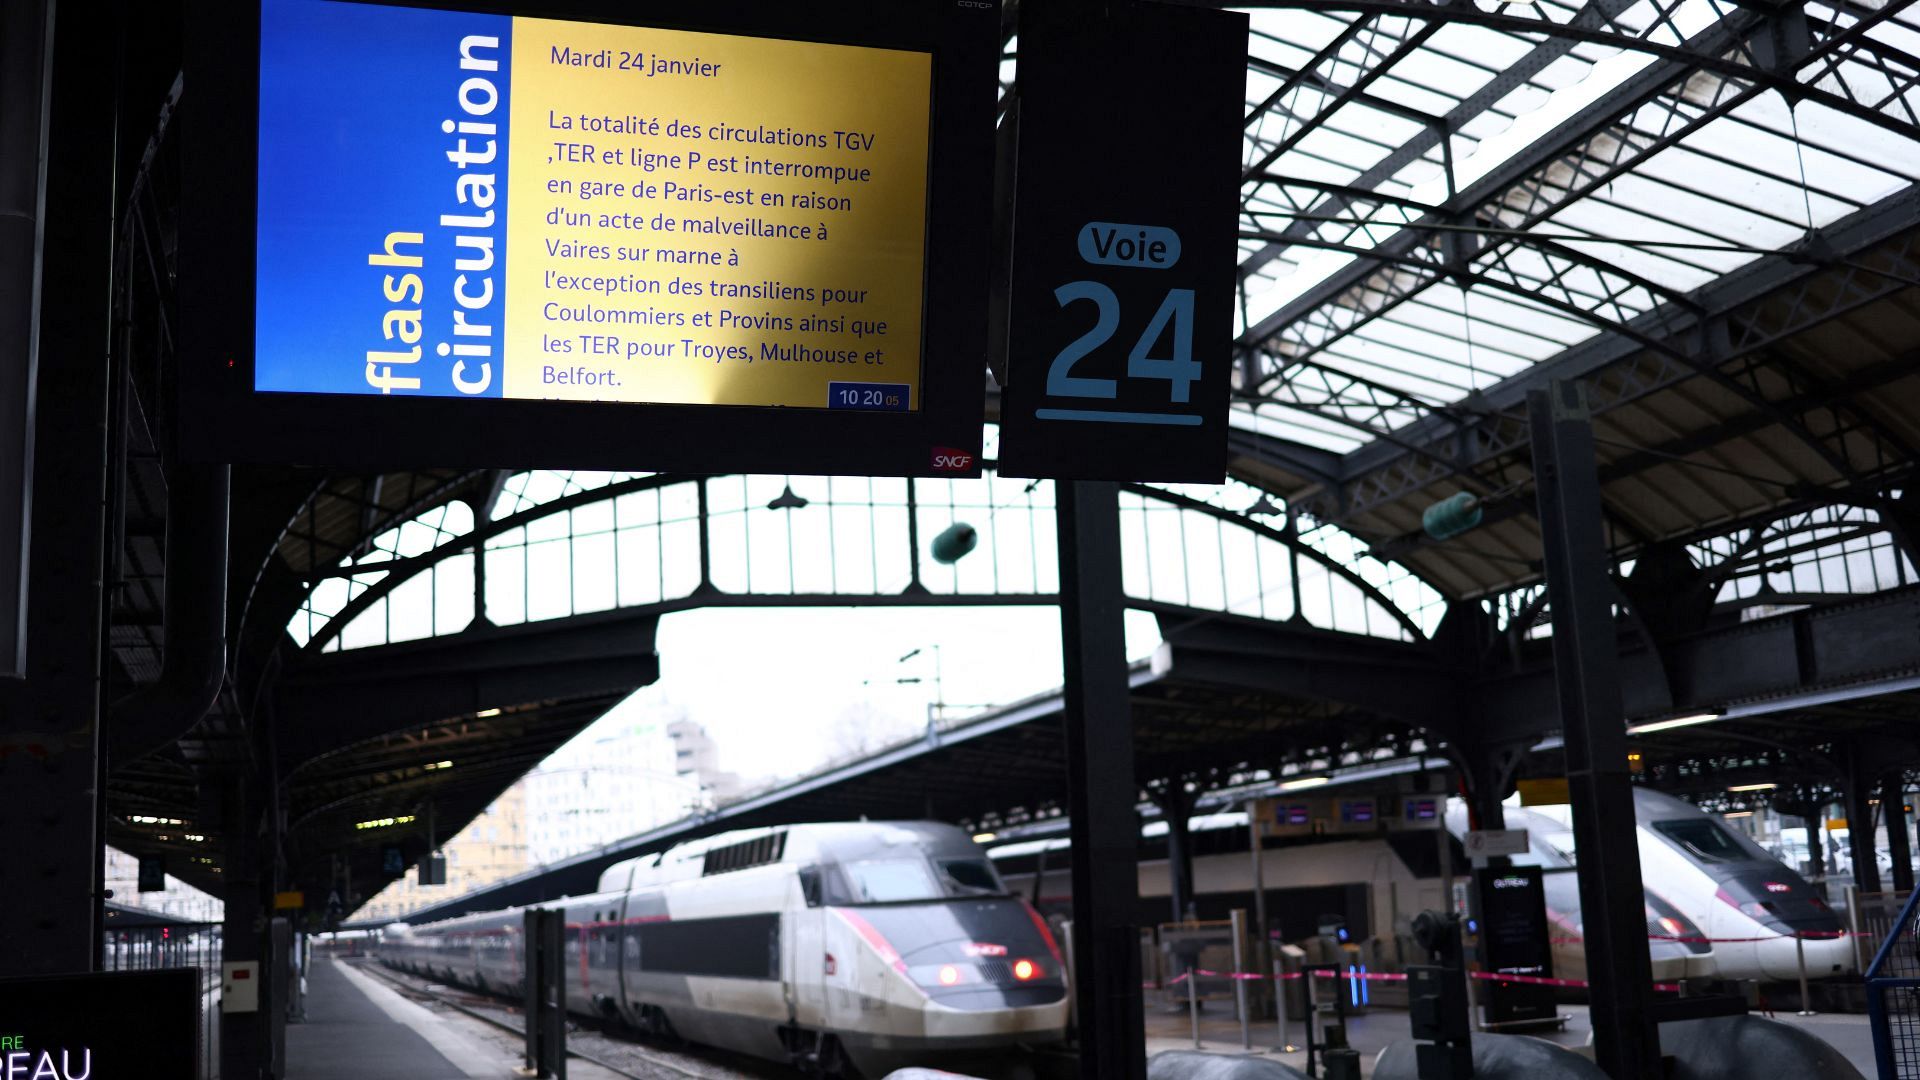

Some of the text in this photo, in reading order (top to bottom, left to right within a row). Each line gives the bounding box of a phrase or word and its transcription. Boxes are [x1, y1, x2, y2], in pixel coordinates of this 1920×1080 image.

[552, 46, 721, 77] Mardi 24 janvier
[550, 111, 875, 151] La totalité des circulations TGV
[549, 143, 870, 184] ,TER et ligne P est interrompue
[548, 180, 850, 211] en gare de Paris-est en raison
[437, 35, 499, 395] circulation
[547, 207, 827, 240] d'un acte de malveillance à
[546, 239, 738, 266] Vaires sur marne à
[1092, 228, 1166, 262] Voie
[546, 271, 867, 306] l'exception des transiliens pour
[365, 232, 424, 394] flash
[544, 303, 887, 339] Coulommiers et Provins ainsi que
[544, 334, 883, 365] les TER pour Troyes, Mulhouse et
[1047, 281, 1202, 403] 24
[544, 366, 620, 385] Belfort.
[840, 390, 899, 405] 10 20 05
[933, 456, 971, 467] SNCF
[0, 1049, 90, 1080] EAU
